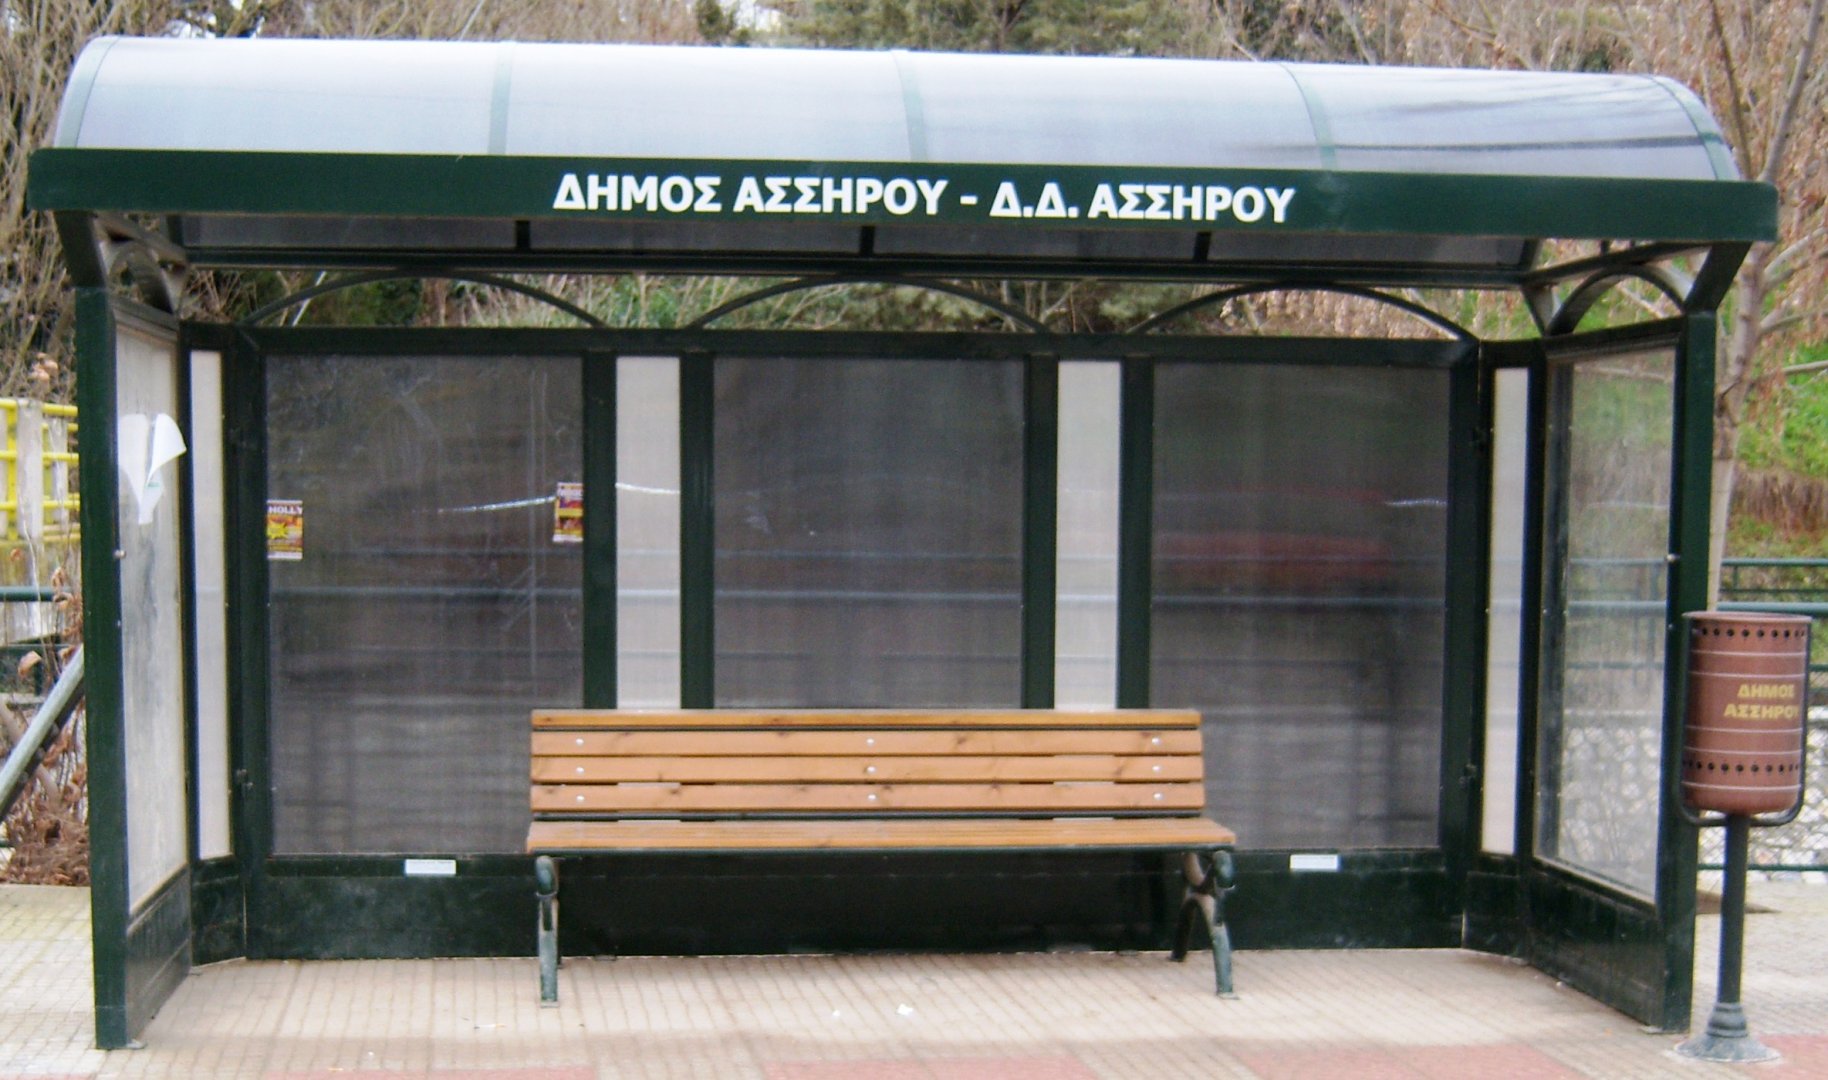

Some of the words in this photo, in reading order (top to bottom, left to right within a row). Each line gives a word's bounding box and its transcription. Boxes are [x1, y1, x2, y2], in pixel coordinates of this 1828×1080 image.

[553, 173, 722, 212] ΔΗΜΟΣ
[733, 175, 948, 215] ΑΣΣΗΡΟΥ
[960, 193, 978, 206] -
[989, 181, 1079, 218] Δ.Δ.
[1088, 183, 1296, 223] ΑΣΣΗΡΟΥ
[1737, 684, 1795, 699] ΔΗΜΟΣ
